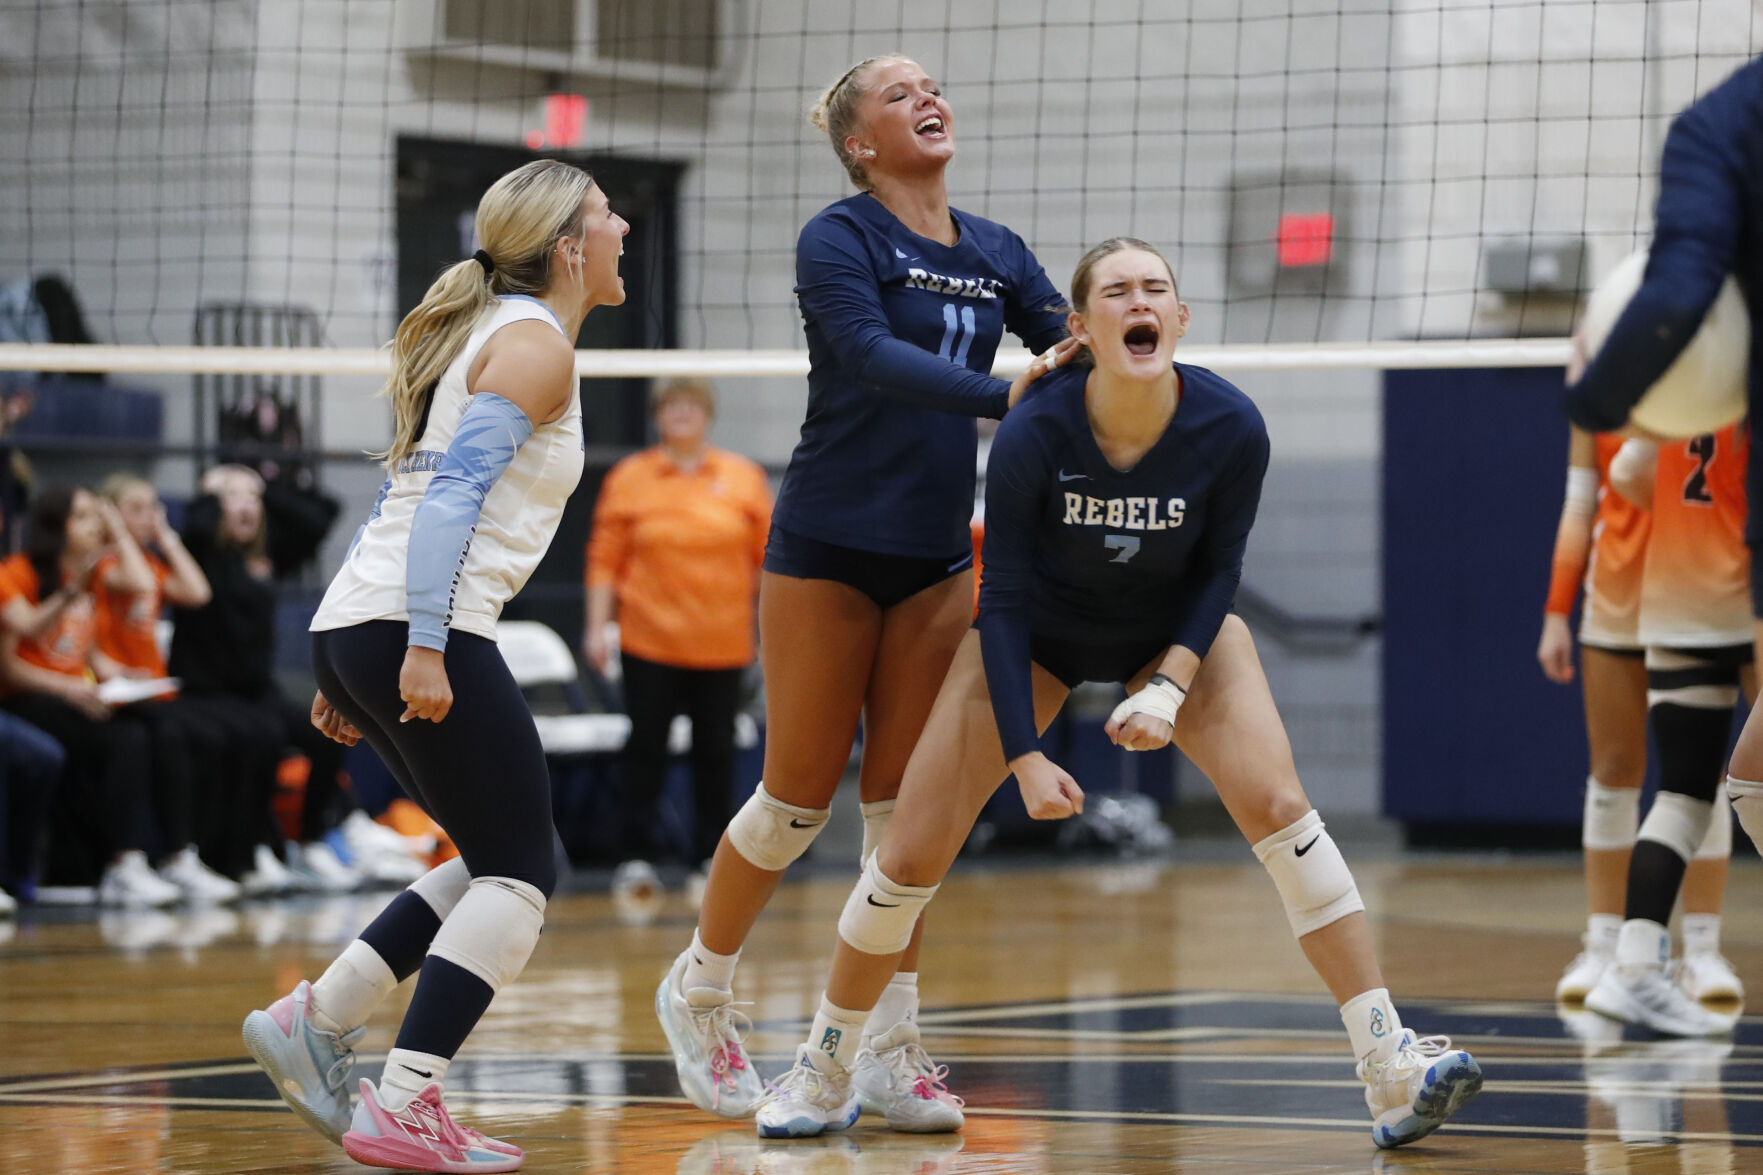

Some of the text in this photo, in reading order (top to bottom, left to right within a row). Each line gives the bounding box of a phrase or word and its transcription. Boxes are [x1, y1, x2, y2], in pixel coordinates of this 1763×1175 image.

[938, 303, 976, 368] 11
[1682, 433, 1717, 506] 2
[1062, 492, 1186, 530] REBELS
[1103, 534, 1141, 563] 7
